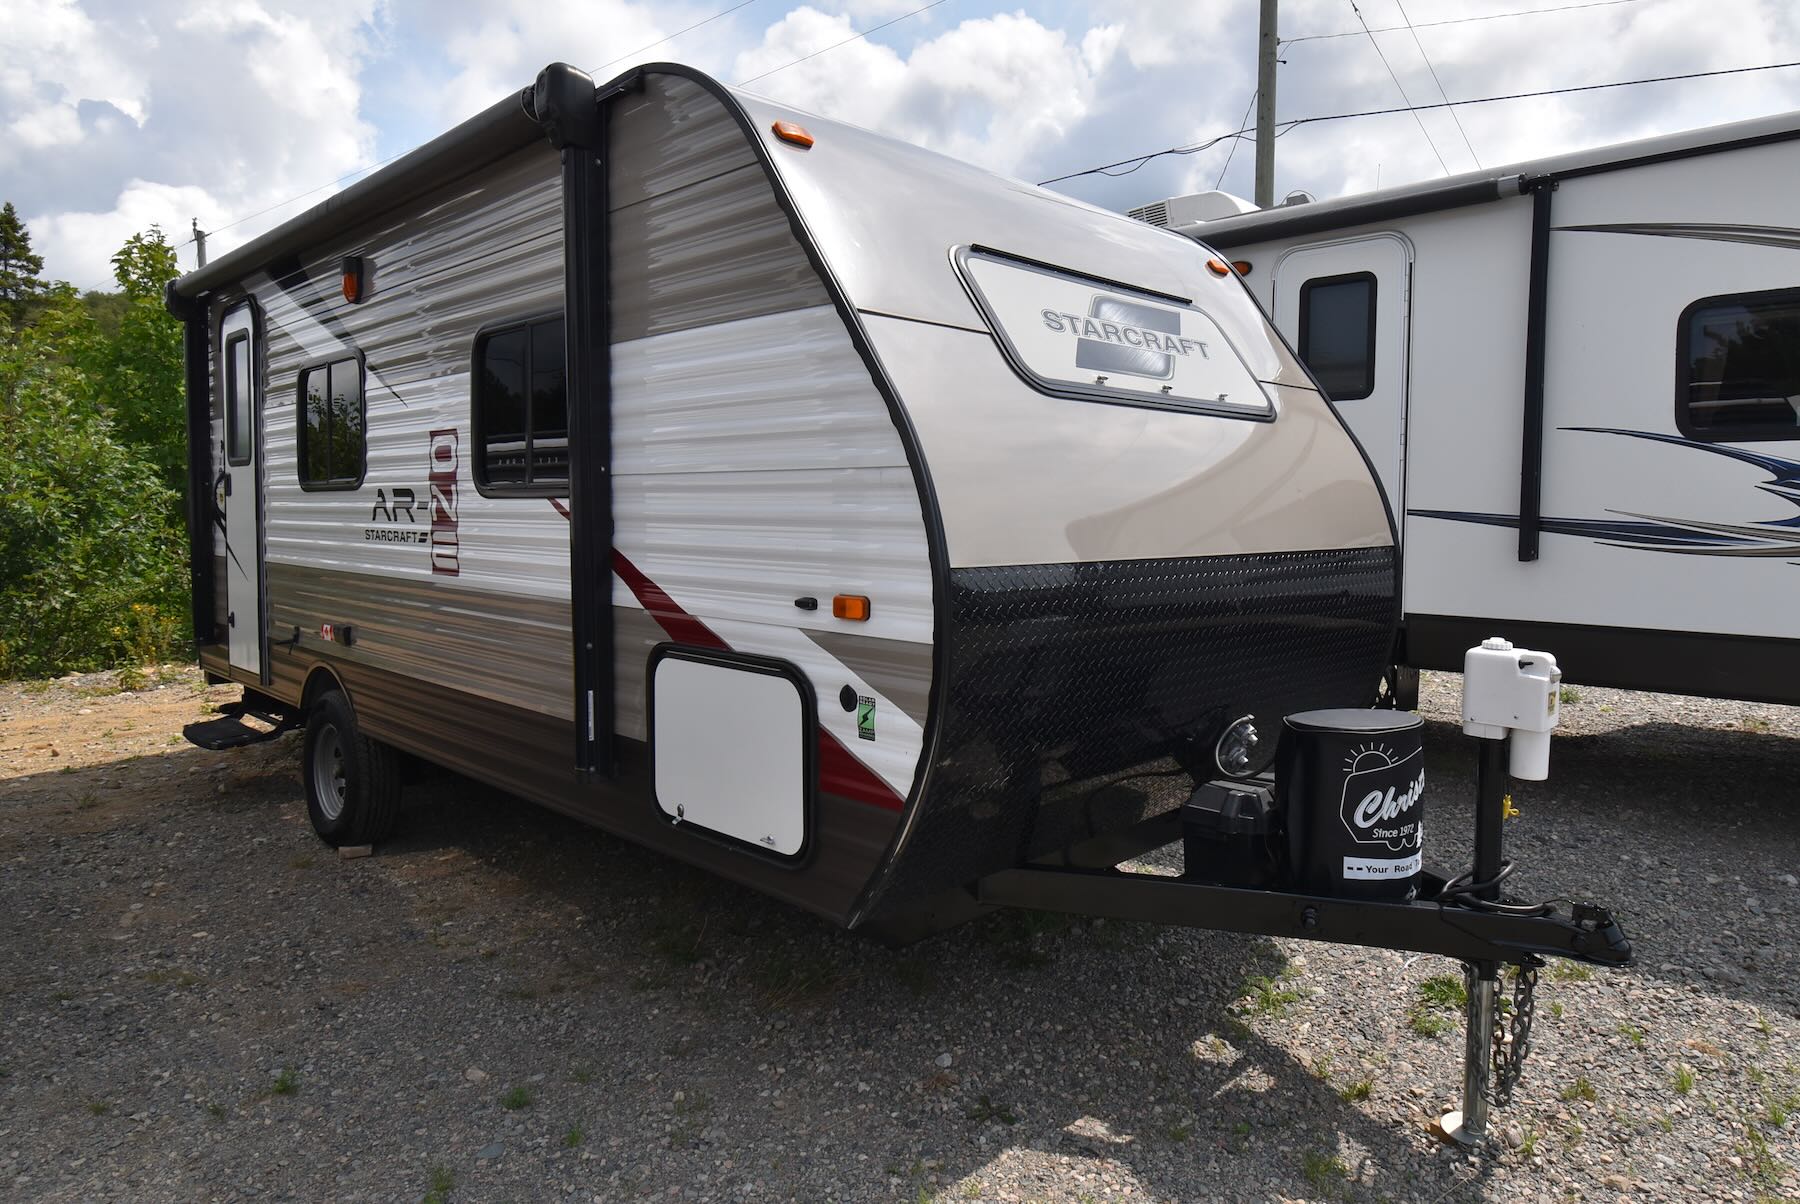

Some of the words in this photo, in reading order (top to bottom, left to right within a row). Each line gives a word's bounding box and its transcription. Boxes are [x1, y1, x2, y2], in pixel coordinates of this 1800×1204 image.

[1041, 308, 1210, 360] STARCRAFT
[365, 529, 418, 543] STARCRAFT
[1372, 828, 1399, 839] Since
[1400, 823, 1415, 836] 1972
[1366, 865, 1389, 874] Your
[1394, 861, 1413, 872] Road
